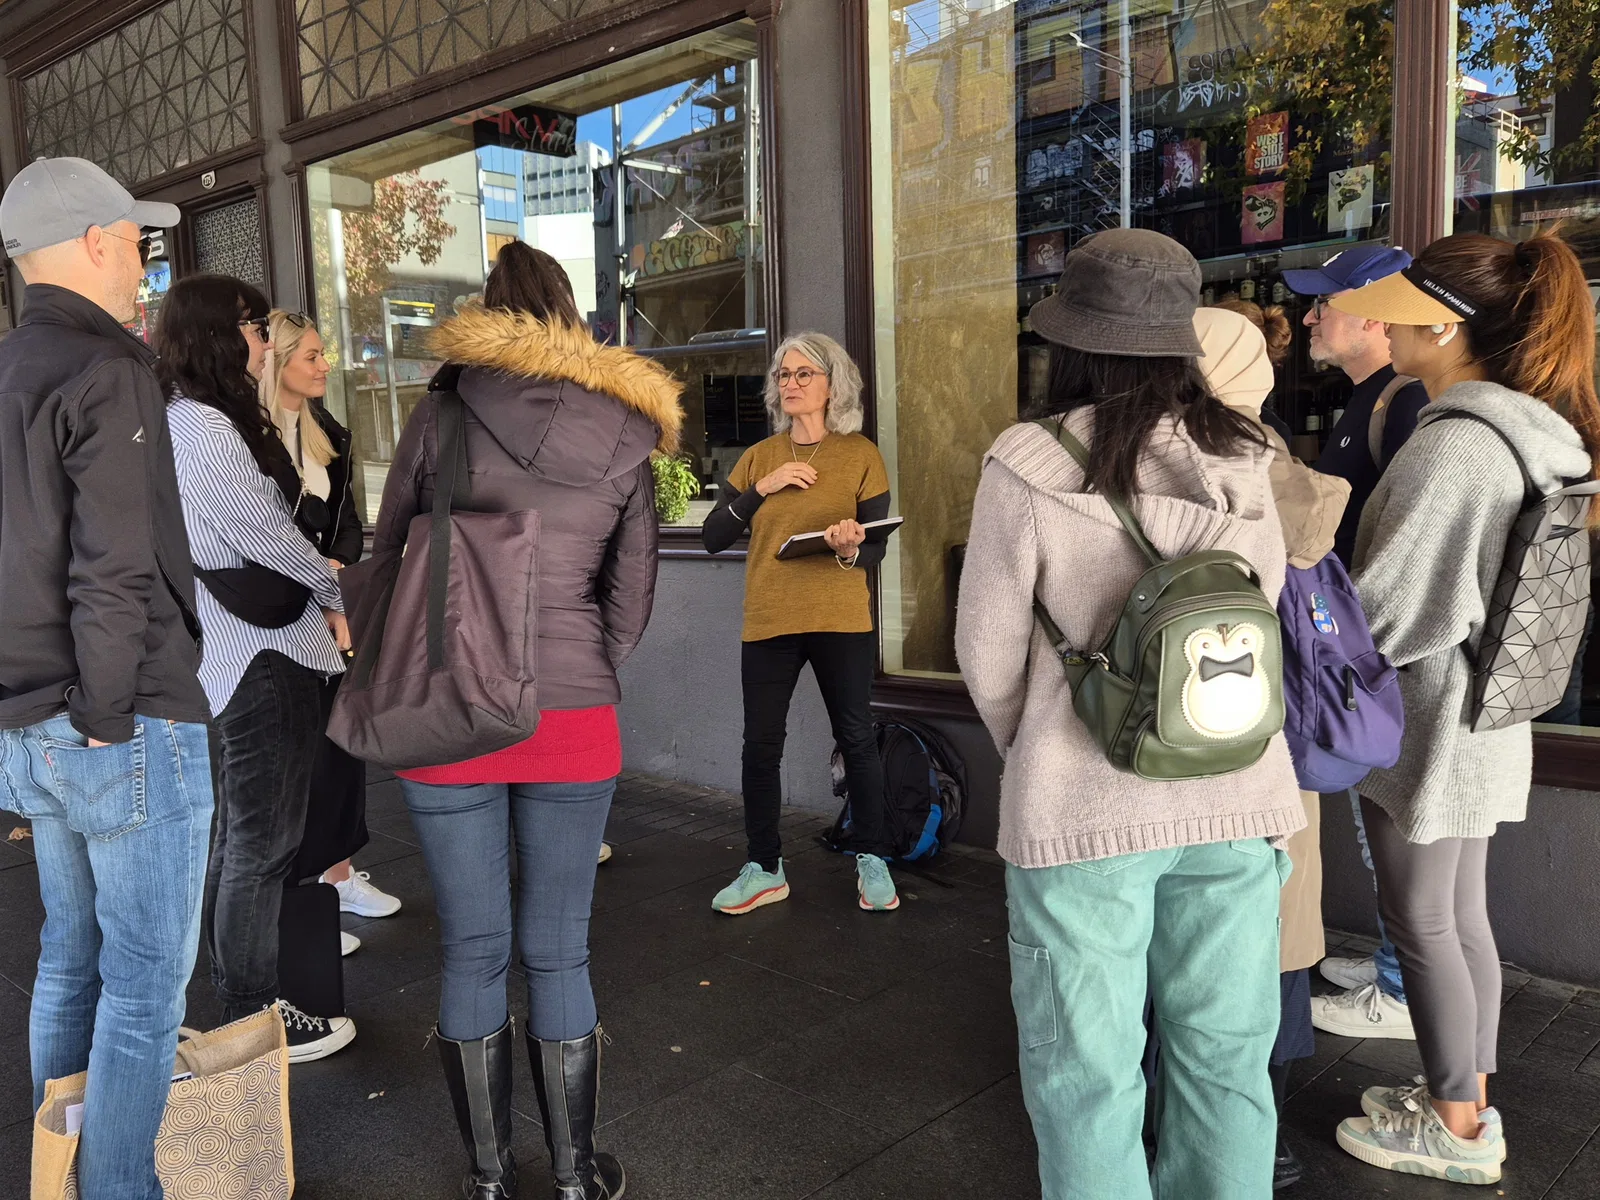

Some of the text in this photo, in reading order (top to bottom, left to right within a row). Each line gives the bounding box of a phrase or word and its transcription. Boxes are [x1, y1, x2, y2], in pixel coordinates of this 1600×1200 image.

[1256, 131, 1284, 147] WEST
[1260, 142, 1284, 157] SIDE
[1254, 153, 1284, 169] STORY
[1423, 279, 1446, 295] HELEN
